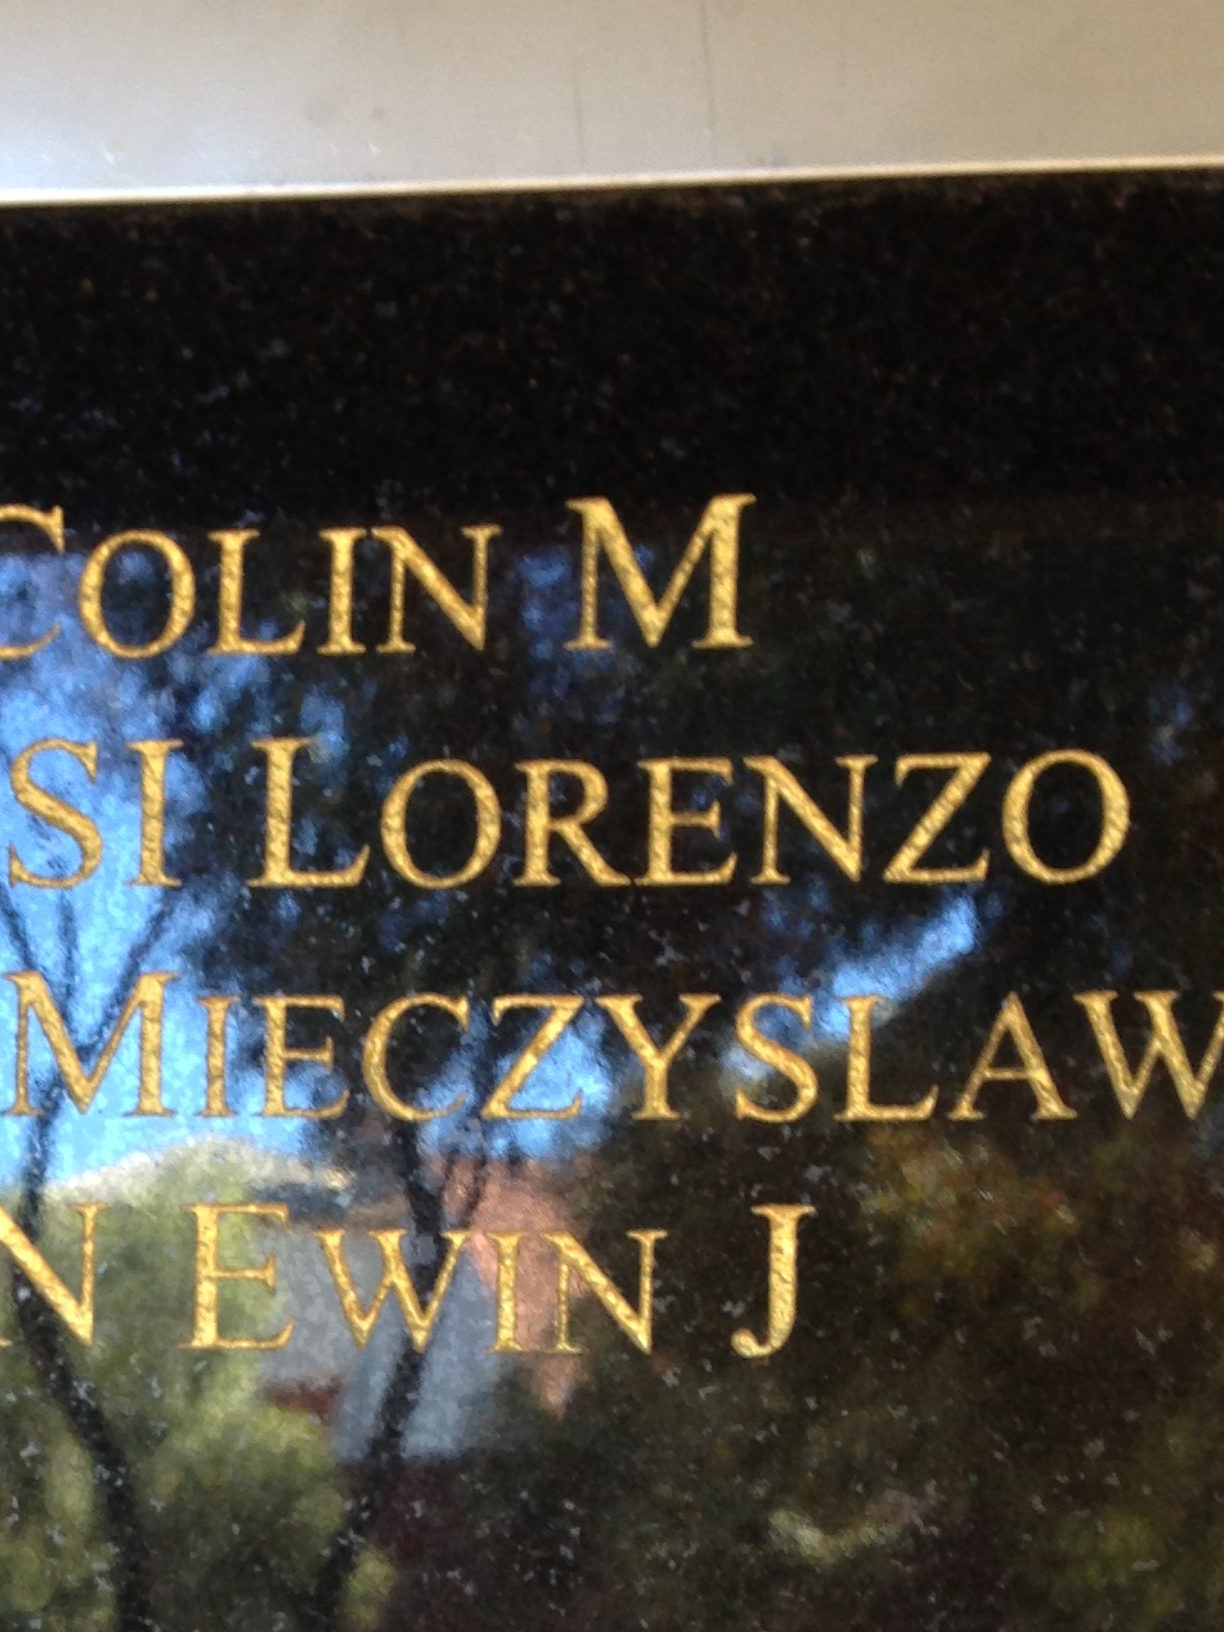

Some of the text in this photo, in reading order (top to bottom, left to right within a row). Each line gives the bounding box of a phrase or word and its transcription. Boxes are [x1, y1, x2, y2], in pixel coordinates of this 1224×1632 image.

[564, 493, 756, 650] M
[246, 735, 1132, 889] LORENZO
[0, 969, 1224, 1122] MIECZYSLAW
[177, 1200, 668, 1356] EWIN
[729, 1203, 817, 1360] J
